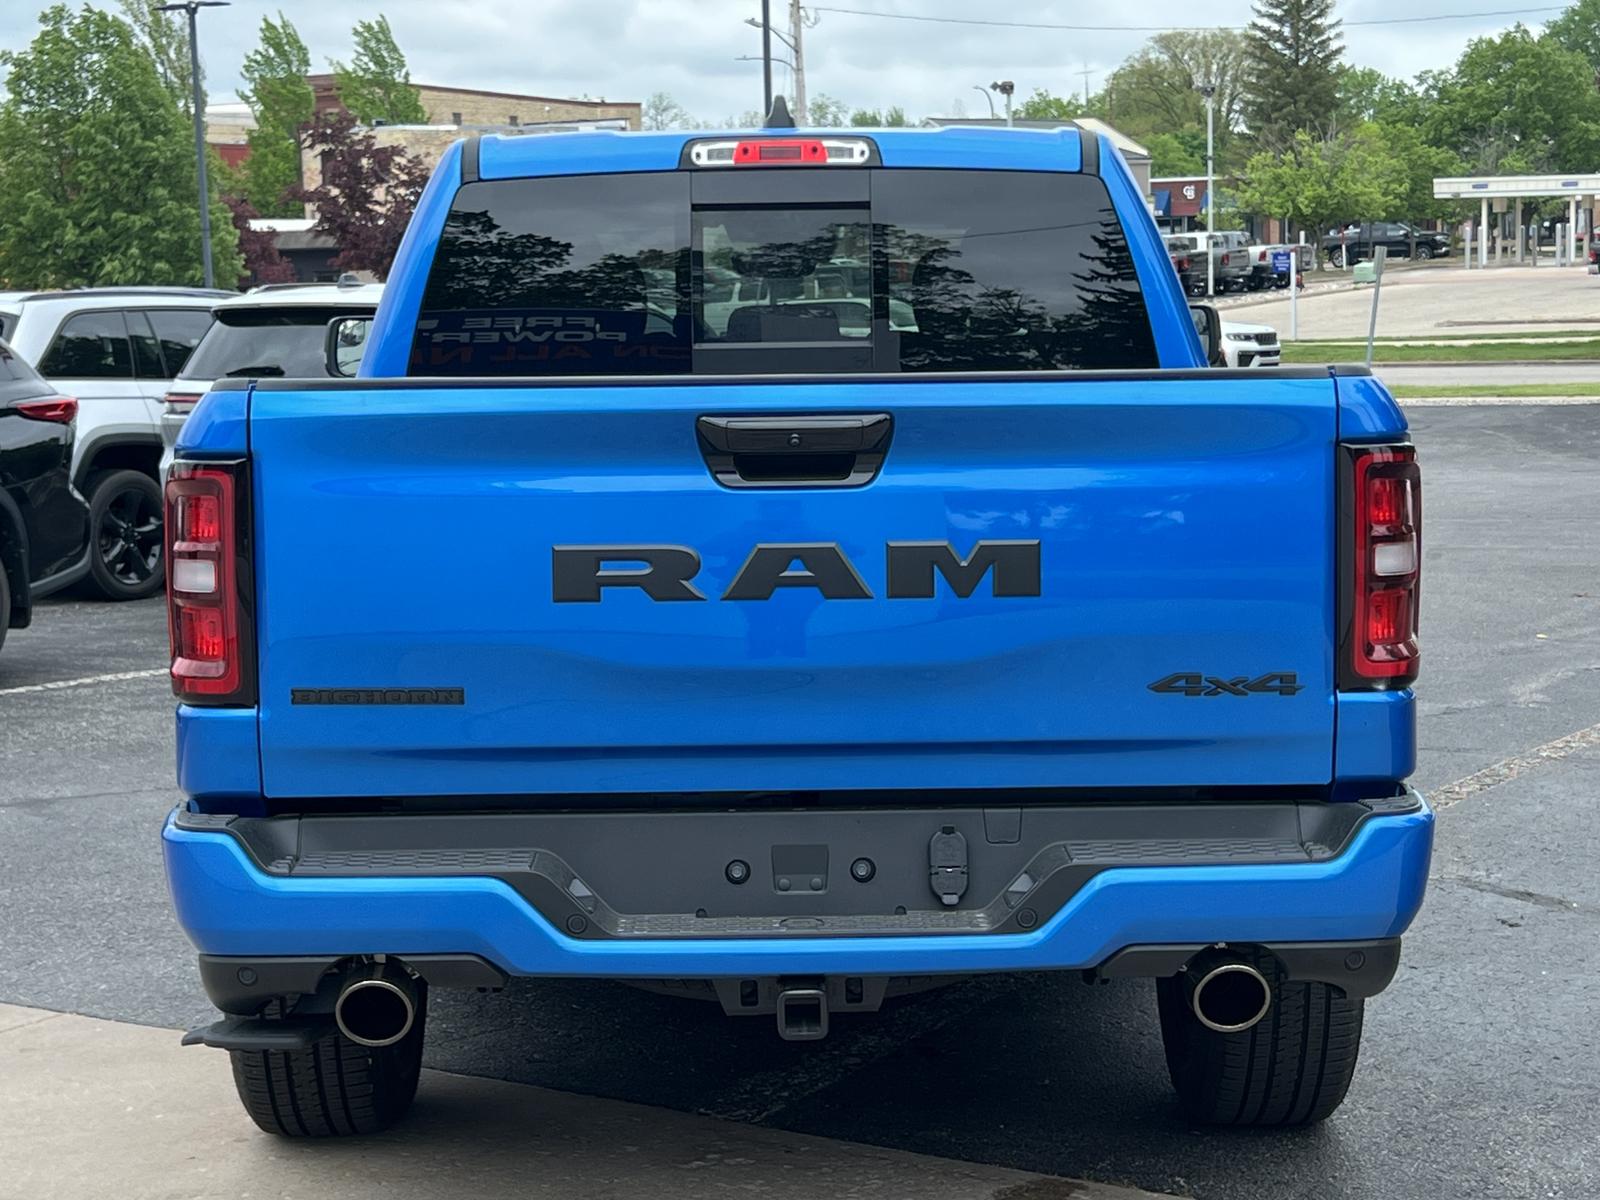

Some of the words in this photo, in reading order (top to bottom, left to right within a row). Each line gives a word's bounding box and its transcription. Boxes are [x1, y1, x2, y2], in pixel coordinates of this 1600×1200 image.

[552, 539, 1041, 603] RAM
[291, 687, 465, 705] BIGHORN
[1147, 671, 1305, 697] 4x4
